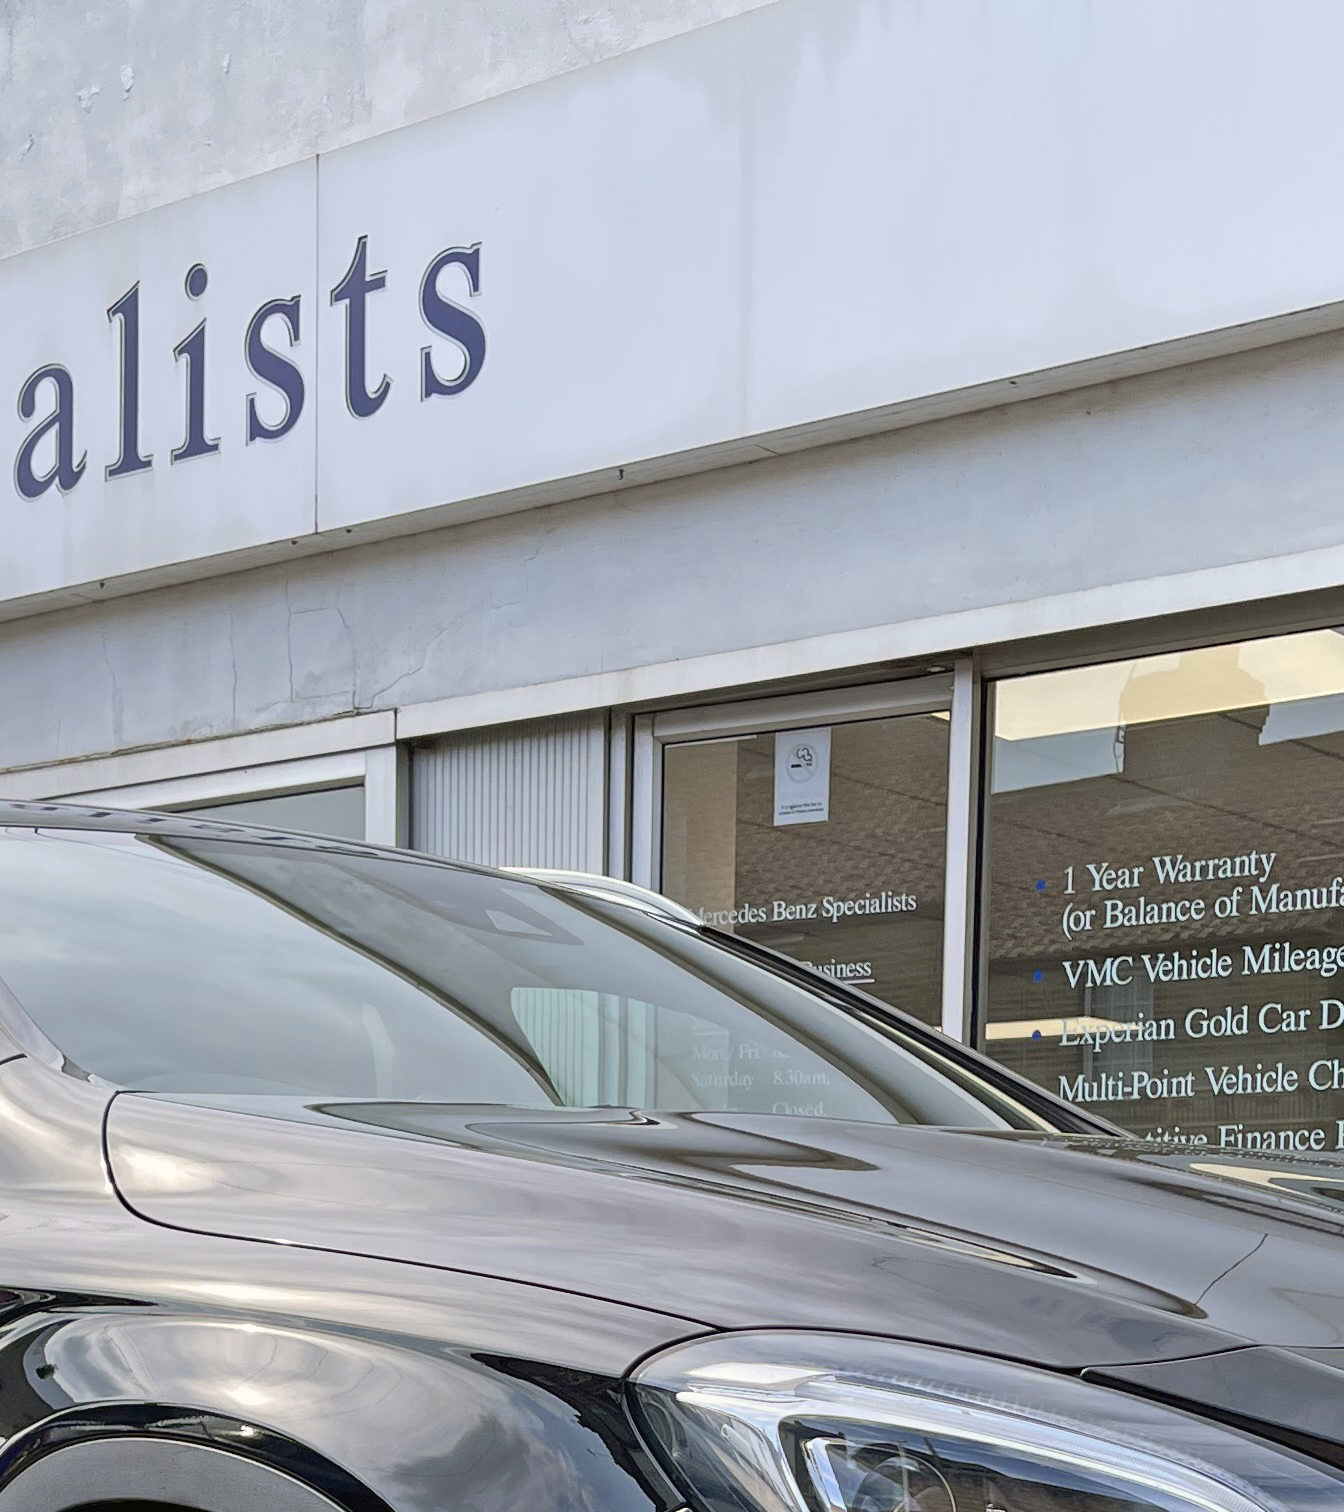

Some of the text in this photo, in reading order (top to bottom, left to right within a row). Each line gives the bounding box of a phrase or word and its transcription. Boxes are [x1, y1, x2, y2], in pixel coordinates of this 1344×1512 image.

[1063, 849, 1277, 895] 1 Year Warranty
[771, 900, 817, 922] Benz
[822, 891, 917, 922] Specialists
[1062, 903, 1096, 941] (or
[1102, 896, 1206, 929] Balance
[1214, 886, 1243, 918] of
[1061, 955, 1134, 989] VMC
[1140, 947, 1233, 983] Vehicle
[1058, 1011, 1176, 1053] Experian
[1184, 1004, 1249, 1039] Gold
[1257, 1002, 1311, 1035] Car
[1058, 1068, 1196, 1103] Multi-Point
[1204, 1061, 1299, 1096] Vehicle
[1218, 1123, 1327, 1150] Finance
